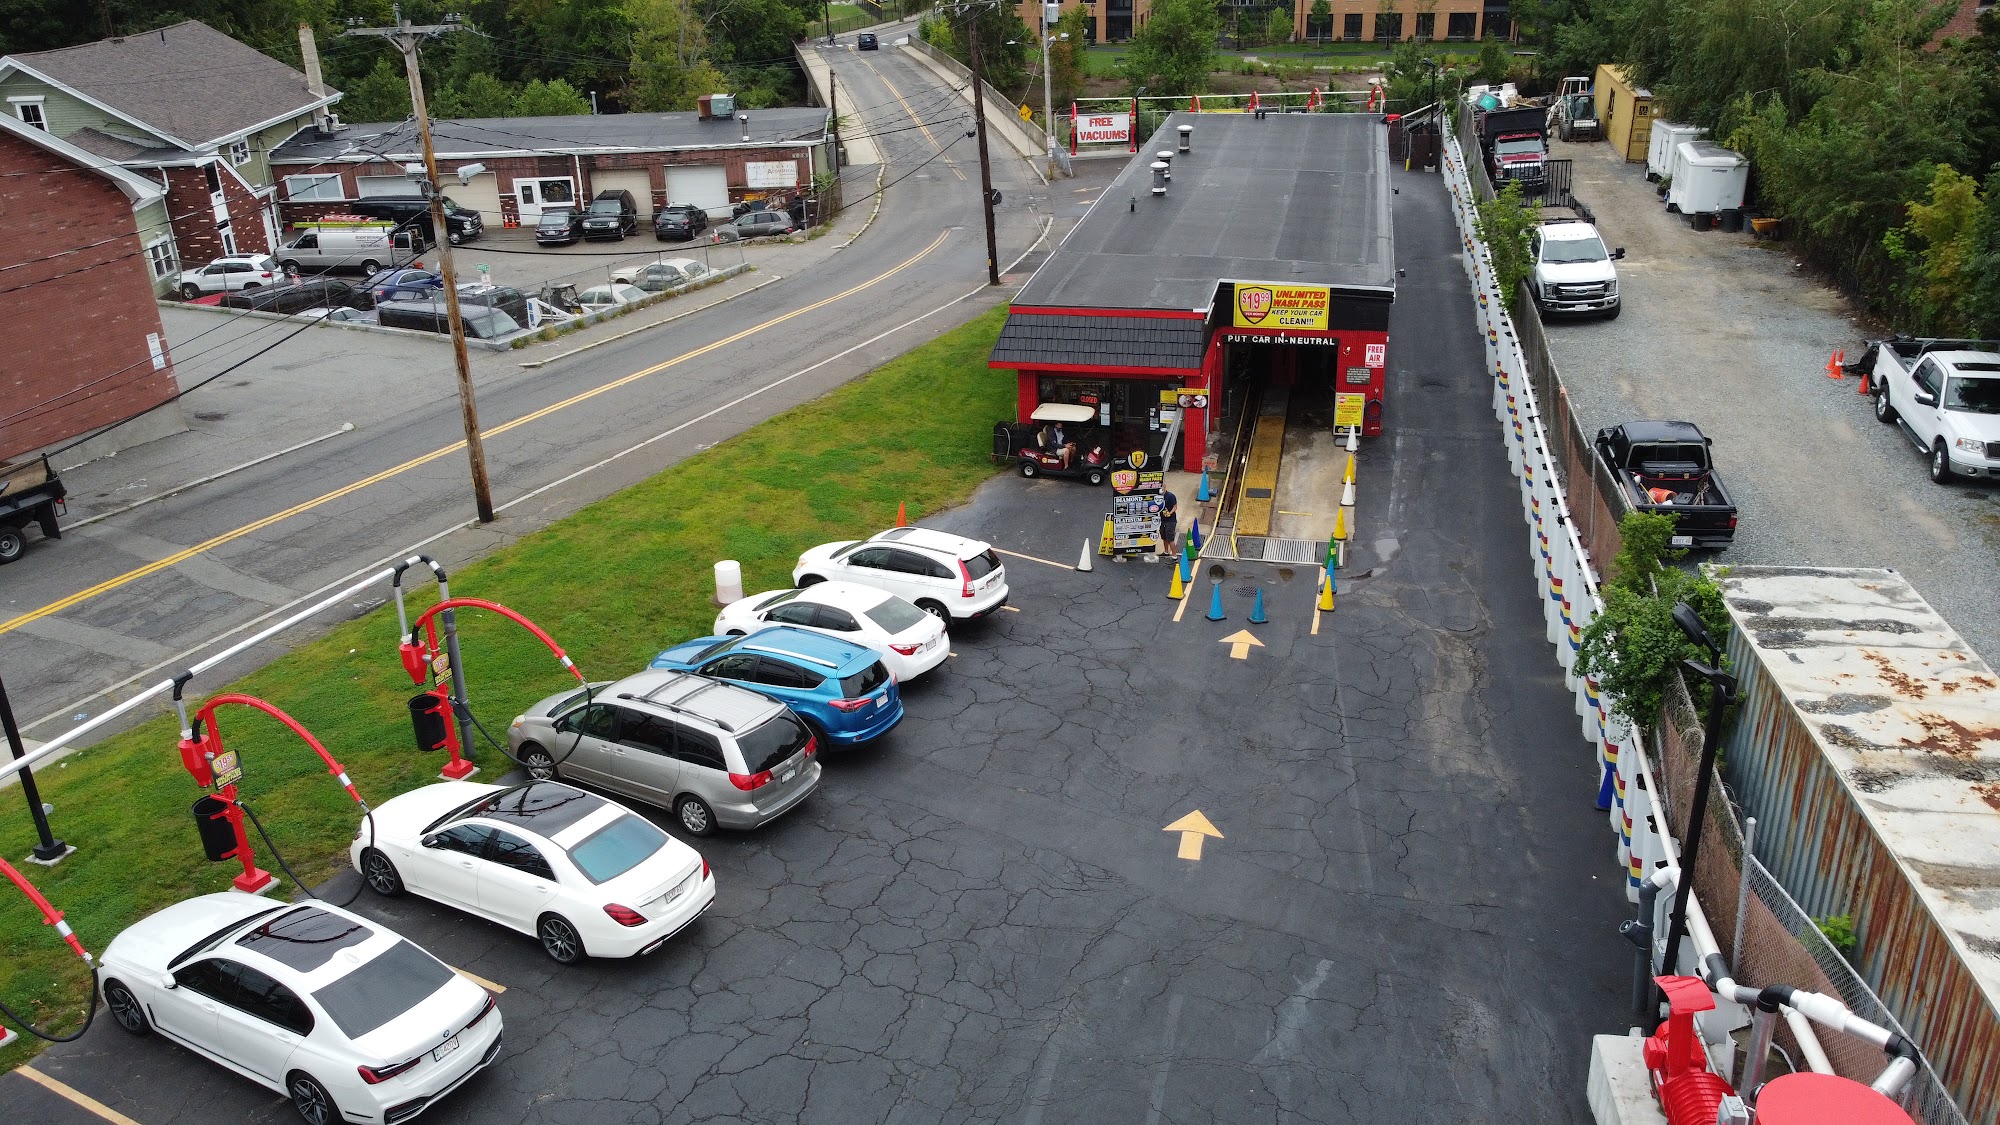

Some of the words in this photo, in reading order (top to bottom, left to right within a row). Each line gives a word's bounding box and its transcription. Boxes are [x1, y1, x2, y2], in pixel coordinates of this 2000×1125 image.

[1089, 117, 1113, 127] FREE
[1080, 130, 1127, 140] VACUUMS
[1276, 290, 1326, 300] UNLIMITED
[1273, 299, 1301, 308] WASH
[1302, 300, 1326, 309] PASS
[1279, 317, 1314, 326] CLEAN!!!
[1080, 395, 1098, 405] CLOSED
[1134, 454, 1142, 463] P
